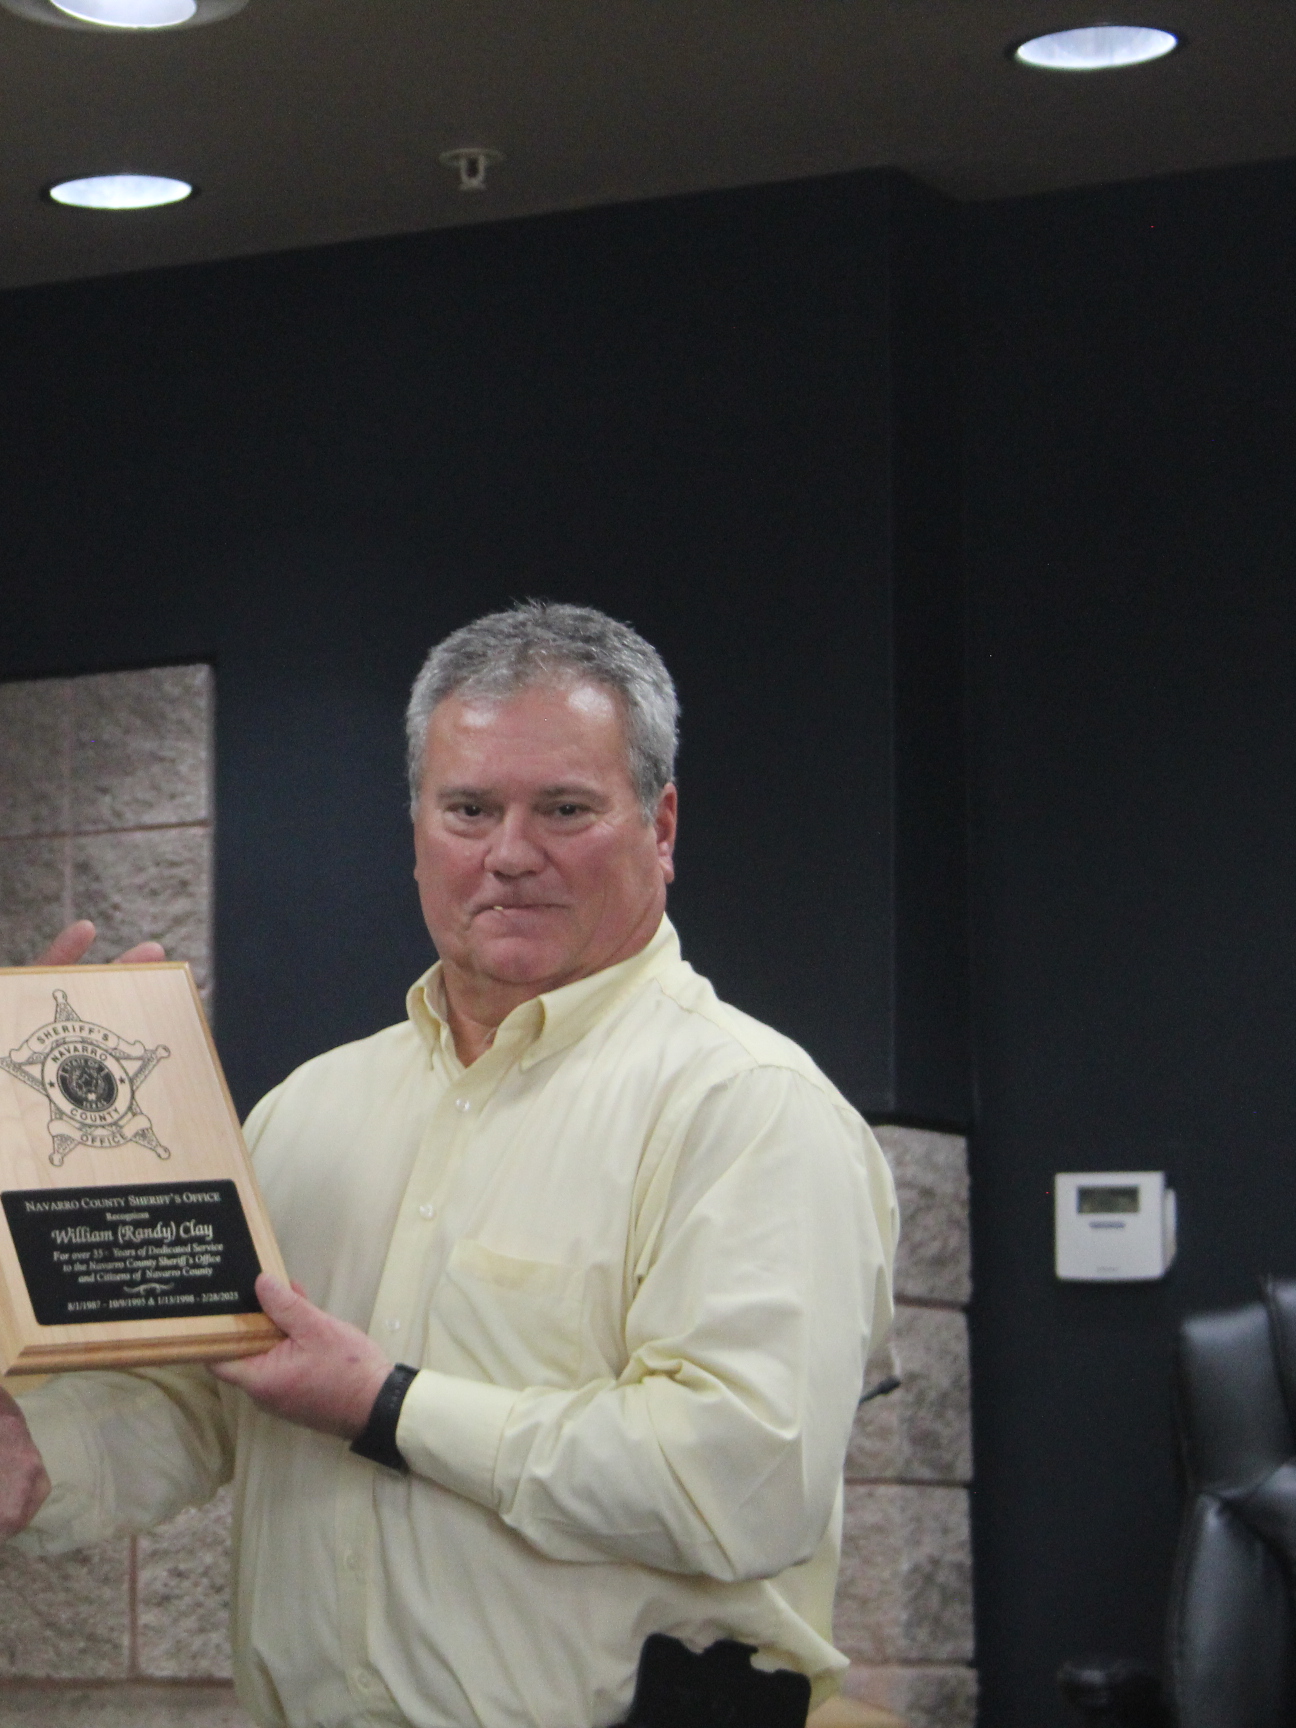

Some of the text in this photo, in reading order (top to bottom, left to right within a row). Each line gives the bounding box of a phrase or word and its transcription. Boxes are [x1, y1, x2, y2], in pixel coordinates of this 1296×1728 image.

[36, 1023, 110, 1045] SHERIFF'S
[50, 1043, 109, 1064] NAVARRO
[69, 1106, 121, 1123] COUNTY
[79, 1132, 129, 1147] OFFICE
[25, 1191, 221, 1212] NAVARRO COUNTY SHERIFF'S OFFICE
[105, 1210, 150, 1222] Recognition
[51, 1219, 214, 1245] William (Randy) Clay
[53, 1251, 70, 1262] For
[72, 1251, 91, 1260] over
[112, 1247, 136, 1258] Years
[137, 1245, 147, 1258] of
[148, 1243, 192, 1255] Dedicated
[193, 1242, 224, 1252] Service
[62, 1253, 222, 1273] to the Navarro County Sheriff's Office
[78, 1265, 213, 1283] and Citizens of Navarro County
